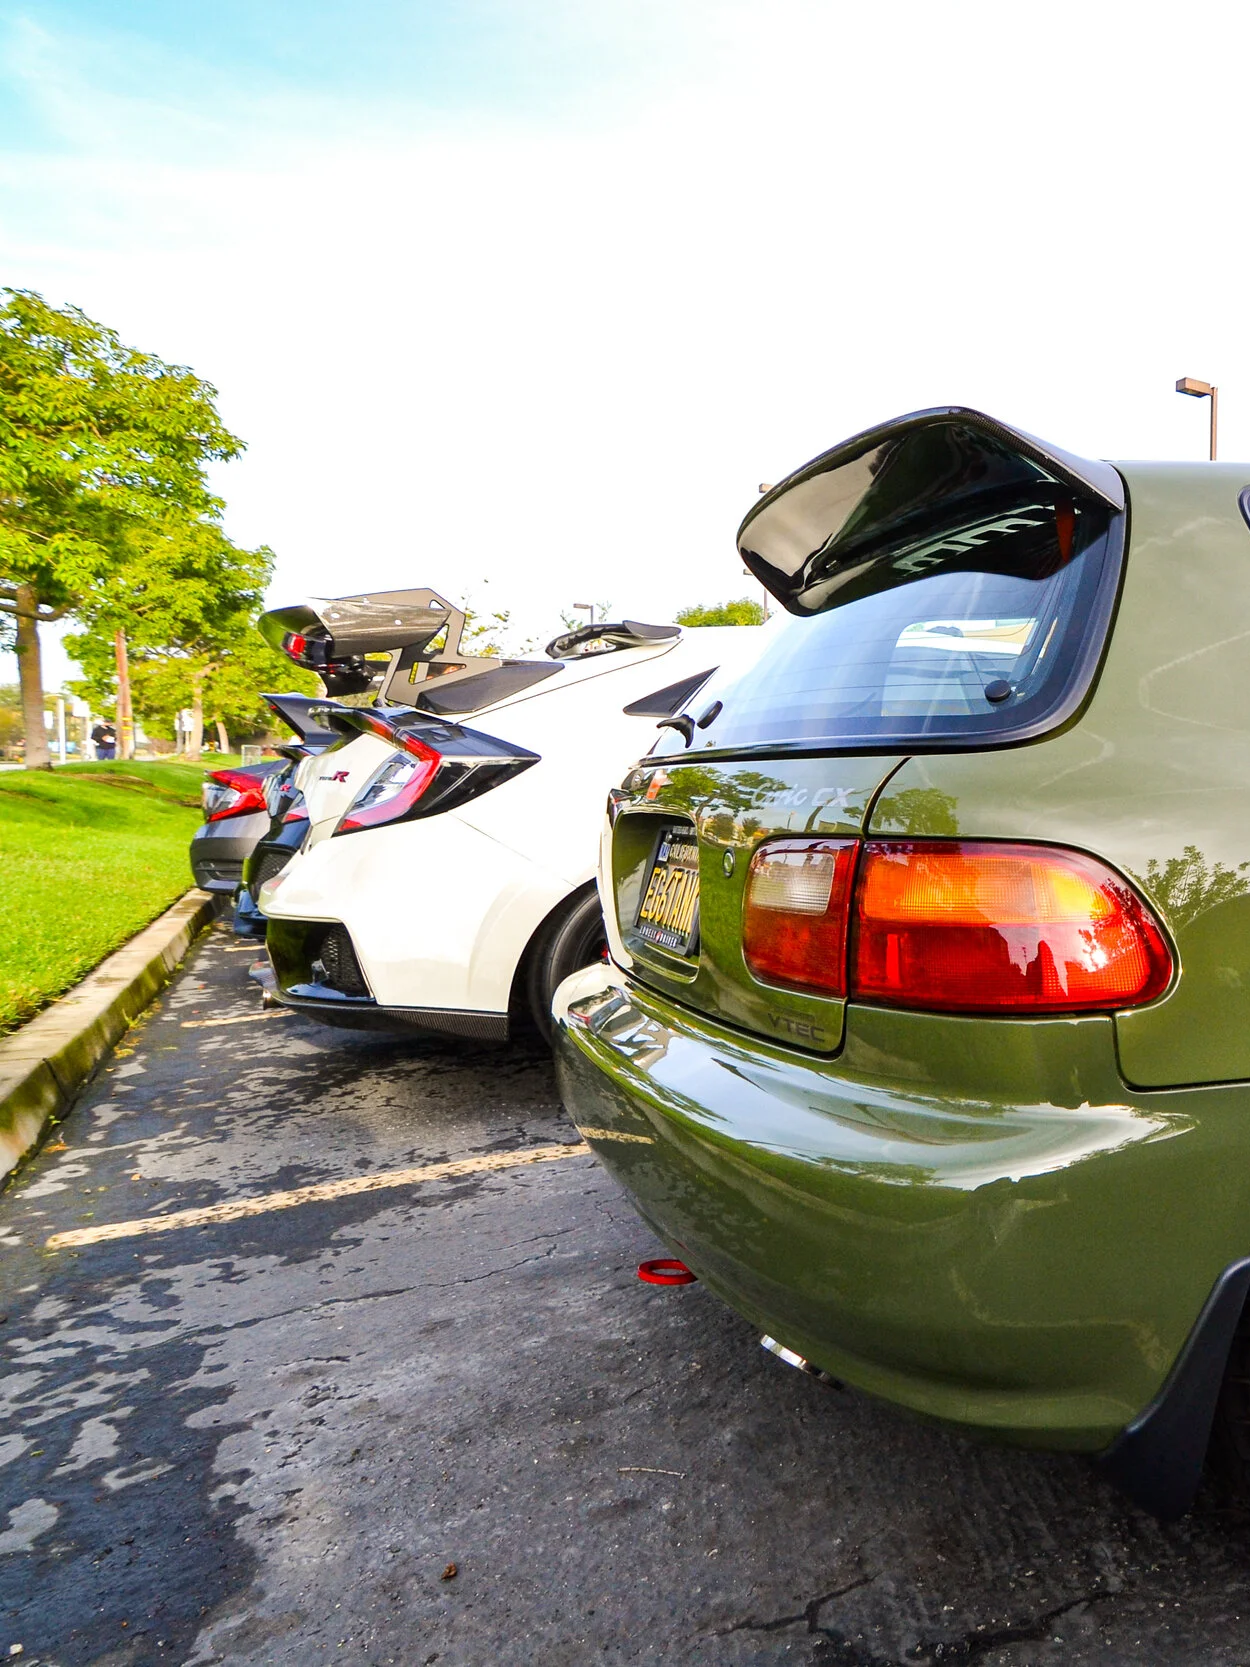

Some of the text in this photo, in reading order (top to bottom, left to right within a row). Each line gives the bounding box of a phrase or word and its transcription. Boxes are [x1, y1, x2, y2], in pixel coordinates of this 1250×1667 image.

[751, 782, 856, 807] Civic CX
[767, 1013, 825, 1043] VTEC
